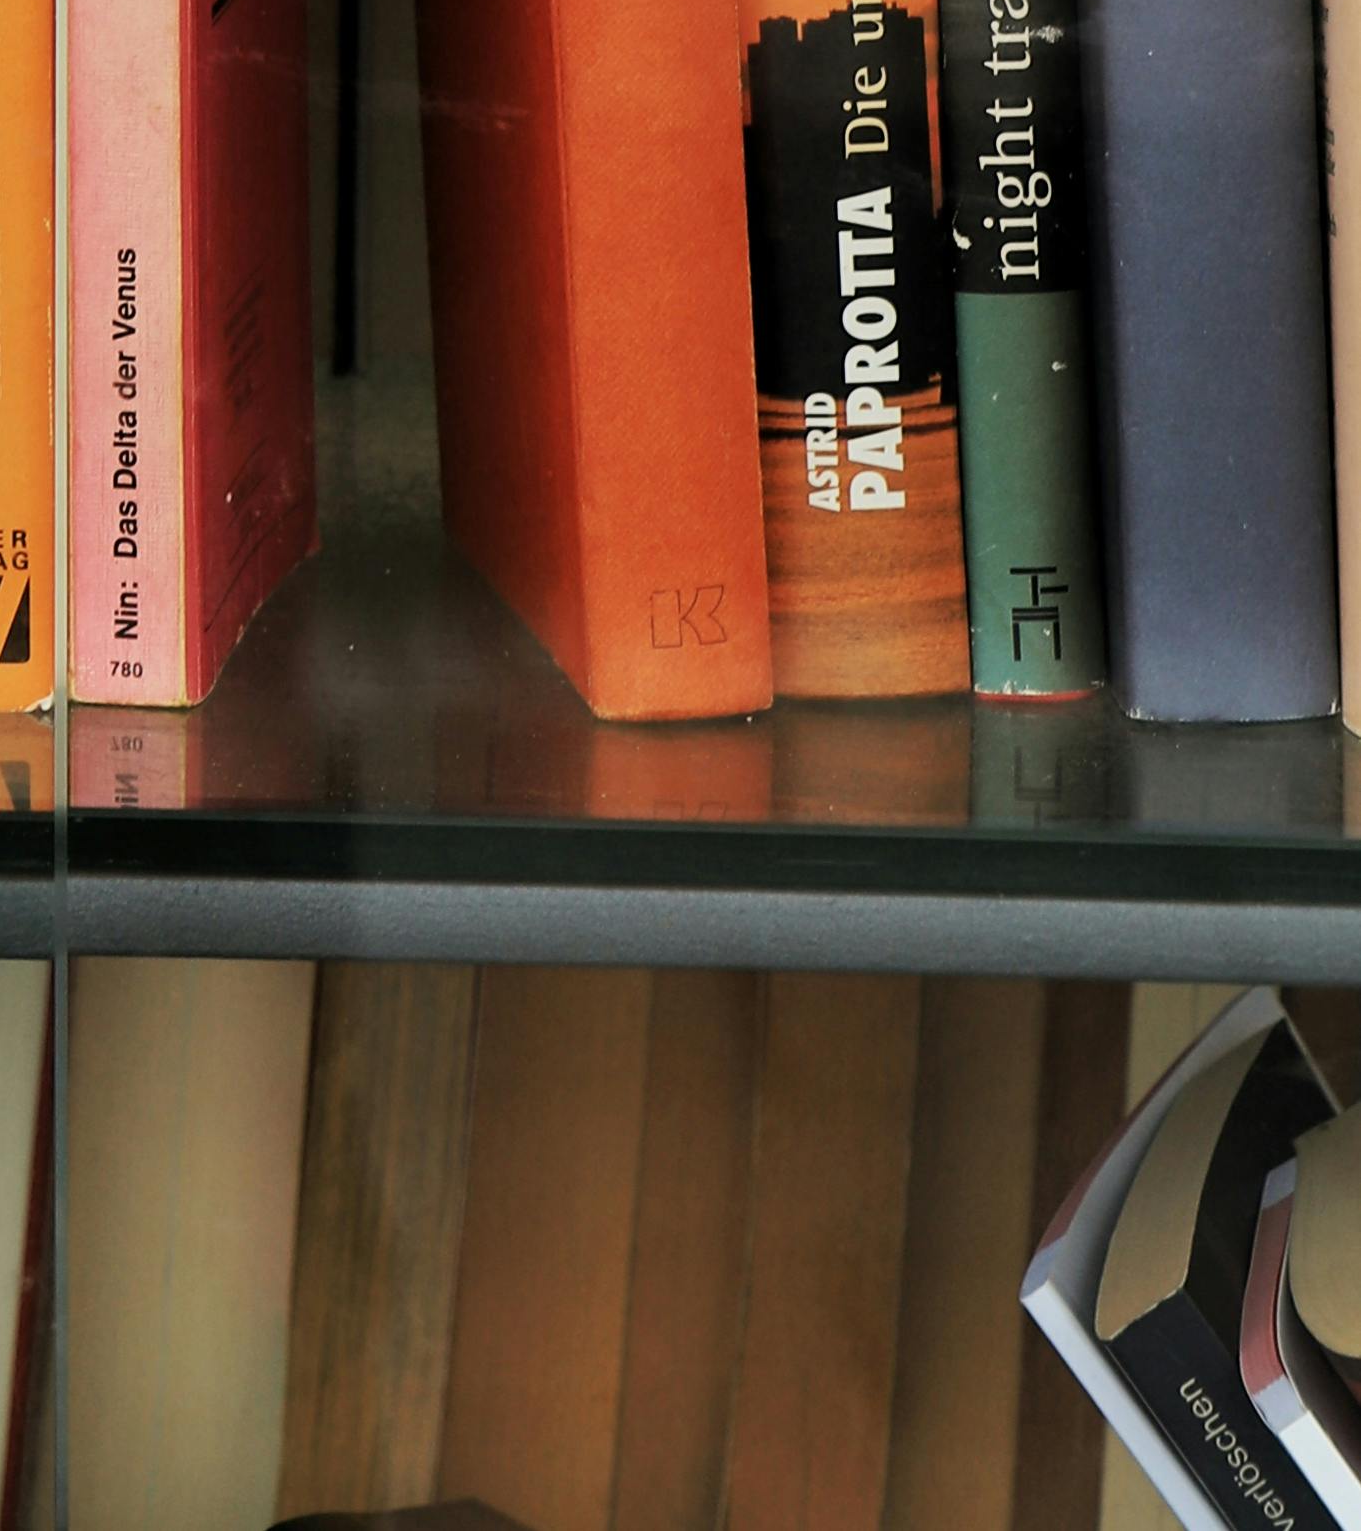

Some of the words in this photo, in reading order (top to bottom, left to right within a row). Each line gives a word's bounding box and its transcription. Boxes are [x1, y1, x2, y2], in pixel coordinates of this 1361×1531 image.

[845, 66, 891, 159] Die
[978, 99, 1051, 281] night
[112, 249, 137, 339] Venus
[118, 348, 138, 400] der
[837, 187, 906, 513] PAPROTTA
[113, 410, 139, 501] Delta
[806, 393, 842, 513] ASTRID
[114, 503, 139, 559] Das
[114, 582, 139, 640] Nin:
[1180, 1377, 1295, 1531] verlöschen
